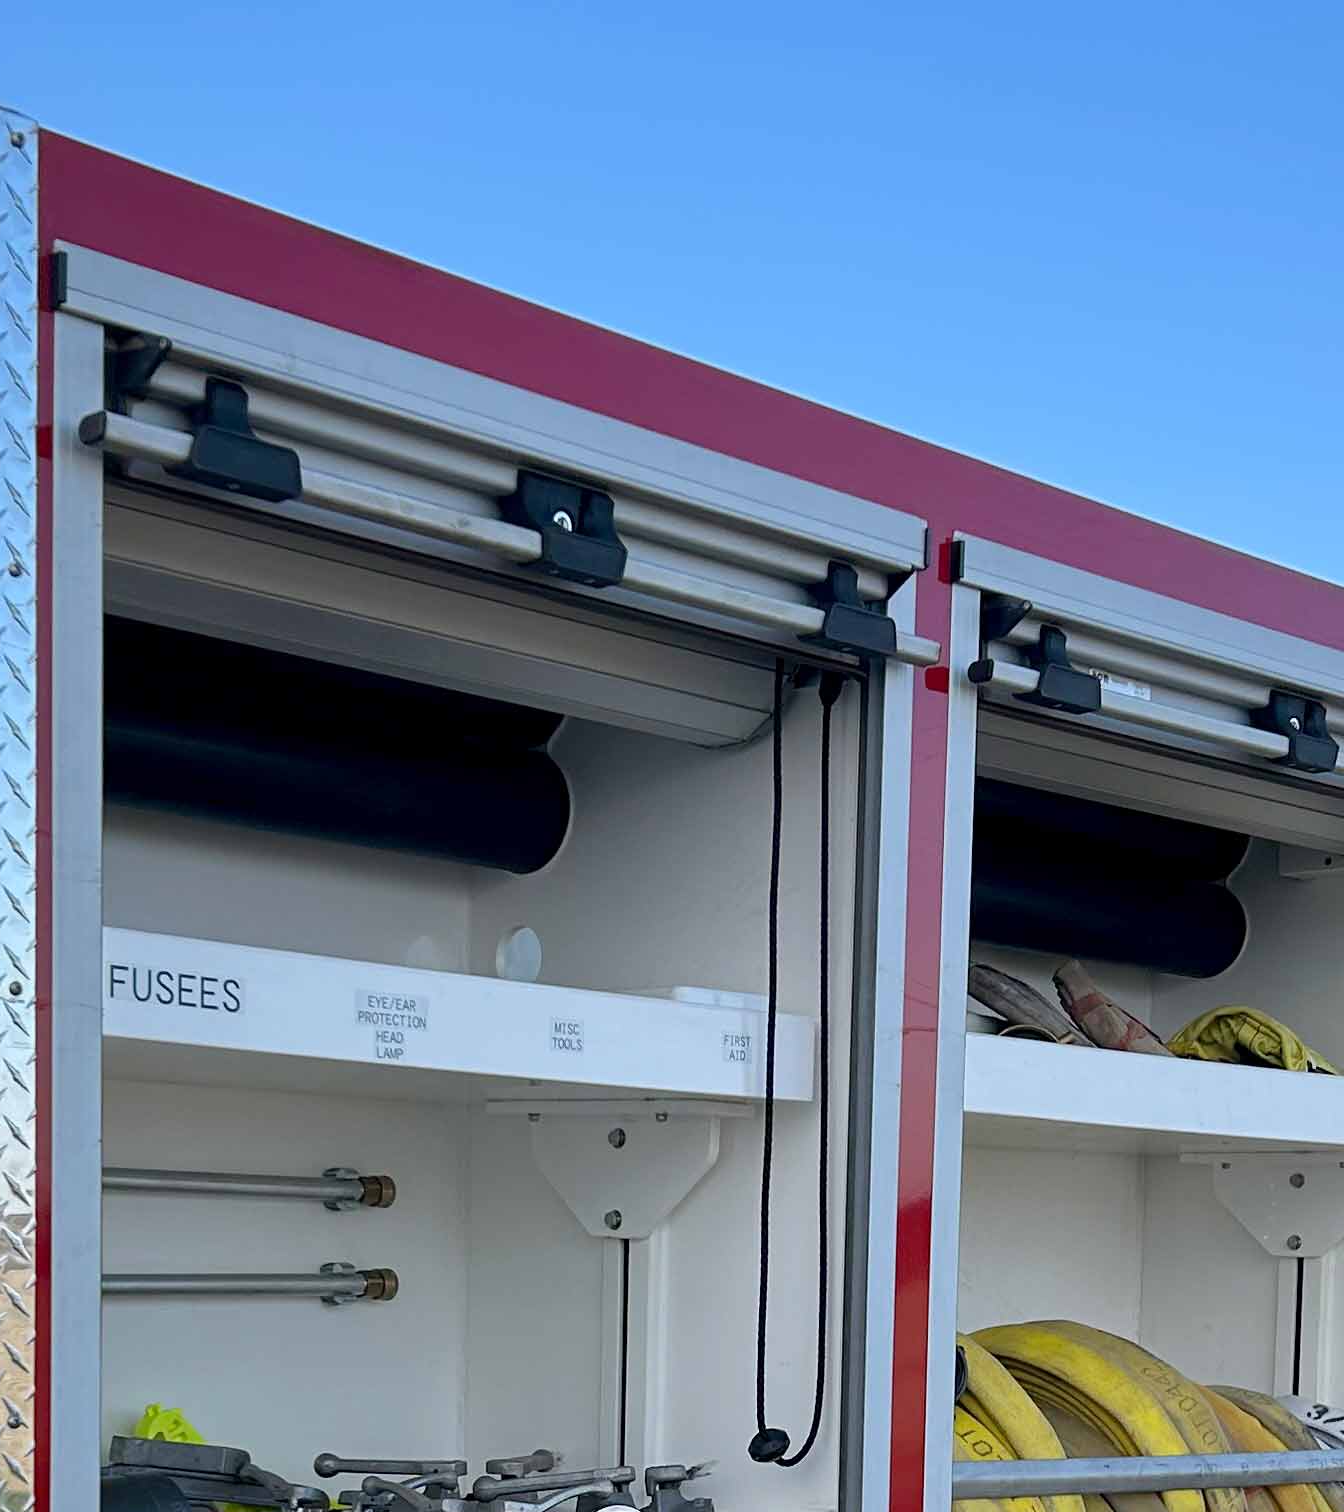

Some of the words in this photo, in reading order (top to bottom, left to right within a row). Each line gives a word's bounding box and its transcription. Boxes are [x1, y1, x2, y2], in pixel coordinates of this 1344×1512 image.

[109, 964, 240, 1013] FUSEES
[367, 994, 417, 1012] EYE/EAR
[358, 1010, 427, 1029] PROTECTION
[554, 1021, 580, 1036] MISC
[376, 1030, 404, 1044] HEAD
[552, 1036, 584, 1051] TOOLS
[723, 1033, 752, 1048] FIRST
[376, 1046, 405, 1061] LAMP
[728, 1049, 747, 1062] AID
